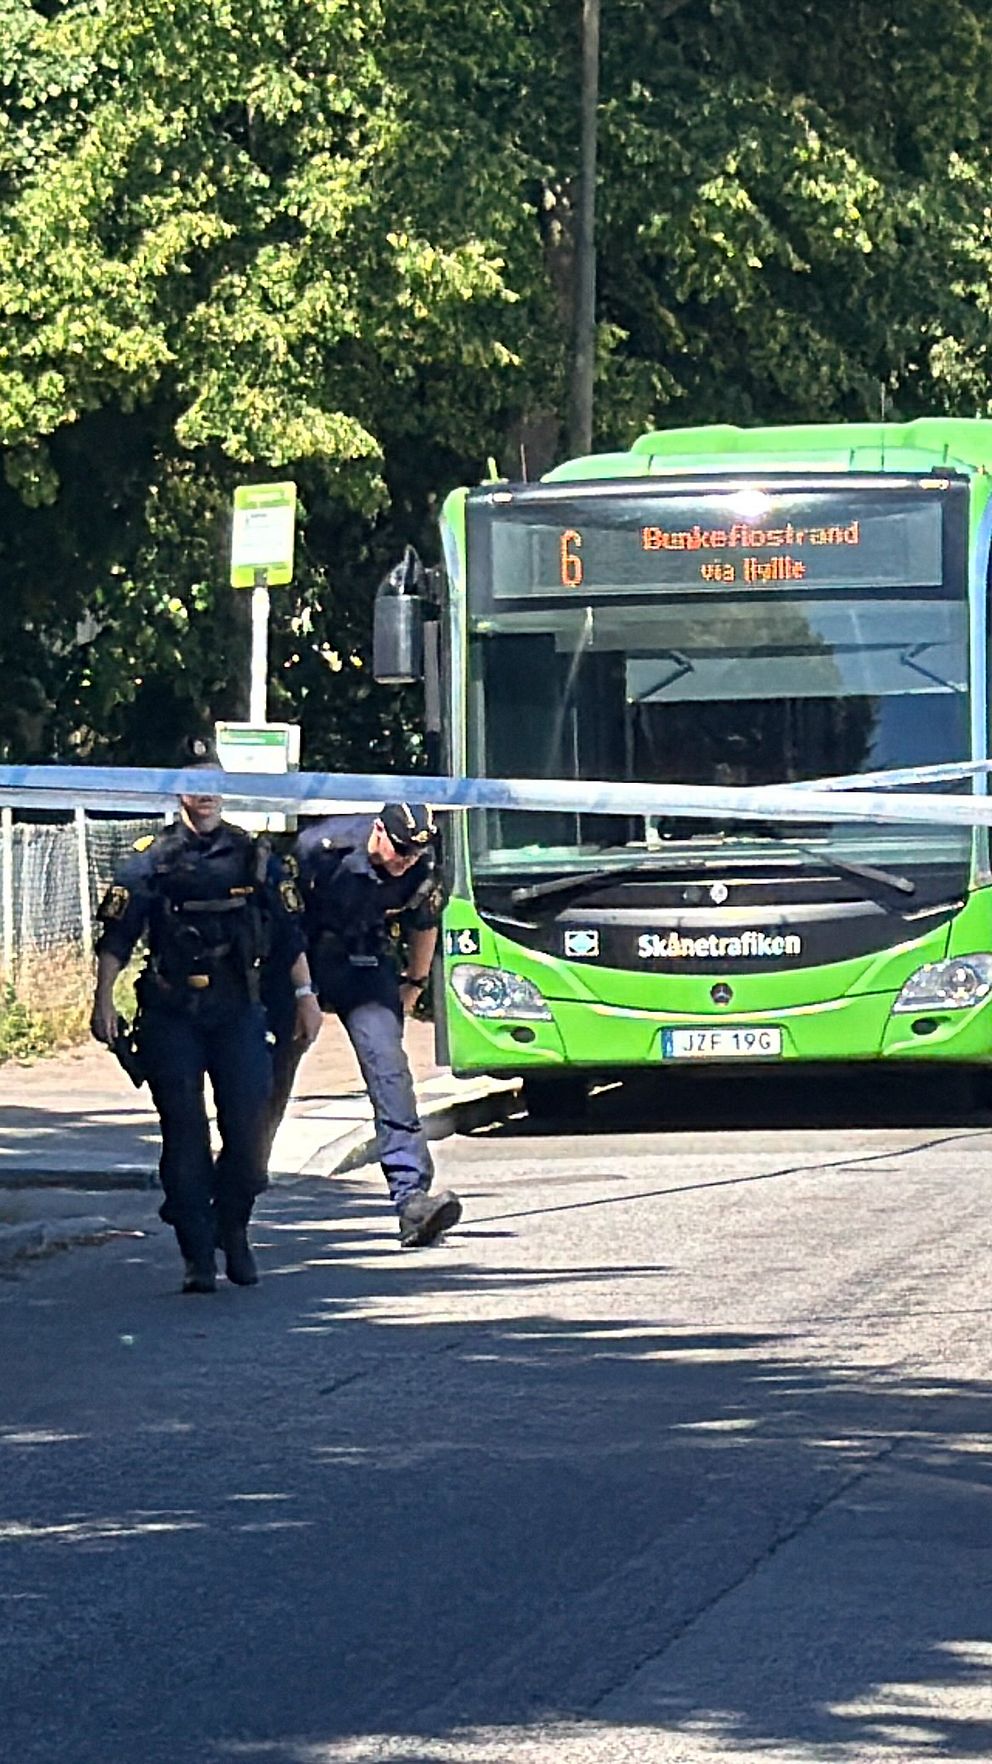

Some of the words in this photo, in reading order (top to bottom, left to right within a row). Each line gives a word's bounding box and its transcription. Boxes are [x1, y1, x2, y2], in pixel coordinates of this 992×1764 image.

[559, 529, 582, 587] 6
[700, 558, 735, 582] via
[637, 930, 801, 958] Skånetrafiken
[683, 1032, 721, 1051] JZF
[732, 1031, 771, 1050] 19G
